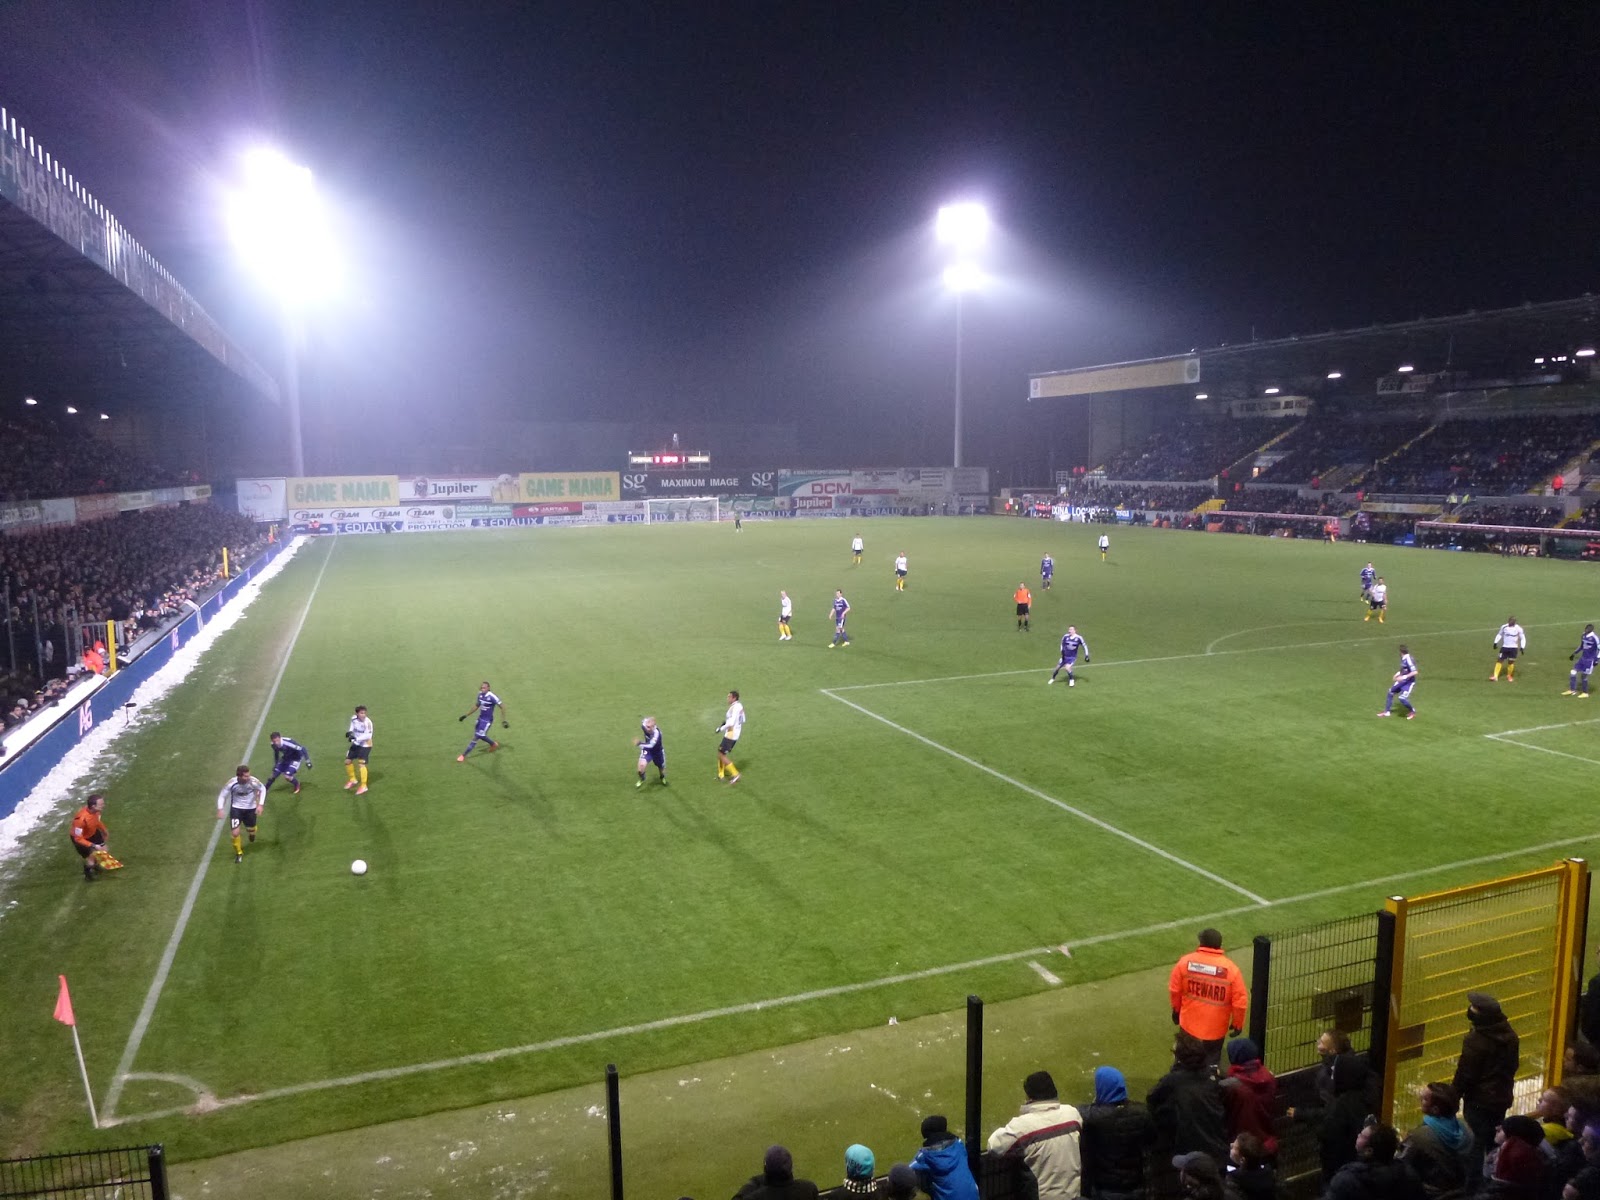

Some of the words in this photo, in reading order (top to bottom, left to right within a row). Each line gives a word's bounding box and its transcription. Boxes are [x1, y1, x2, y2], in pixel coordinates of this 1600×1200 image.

[527, 478, 564, 497] GAME
[569, 478, 612, 496] MANIA
[661, 479, 705, 487] MAXIMUM
[709, 478, 739, 486] IMAGE
[811, 483, 851, 494] DCM
[295, 482, 337, 502] GAME
[342, 480, 391, 501] MANIA
[432, 483, 478, 496] Jupiler
[793, 497, 831, 509] Jupiler
[865, 508, 903, 516] EDIALUX
[490, 517, 538, 527] EDIALUX
[1187, 979, 1226, 1001] STEWARD
